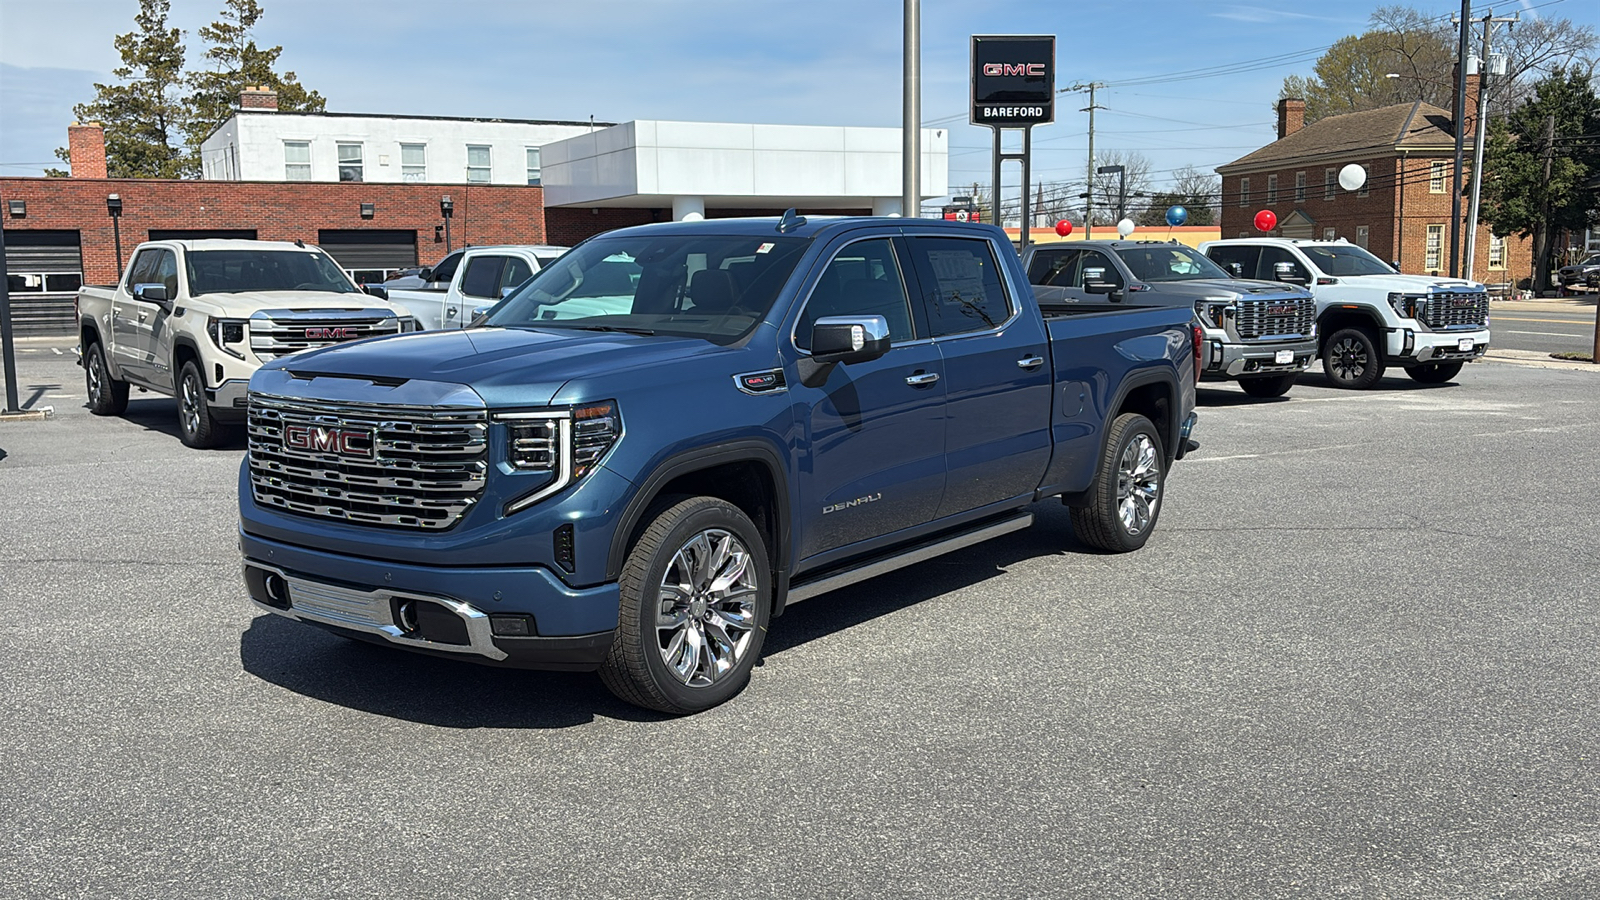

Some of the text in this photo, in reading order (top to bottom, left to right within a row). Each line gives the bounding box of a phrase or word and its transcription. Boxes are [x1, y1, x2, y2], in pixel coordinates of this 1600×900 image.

[983, 62, 1046, 77] GMC
[983, 106, 1044, 118] BAREFORD
[305, 327, 358, 339] GMC
[286, 424, 372, 456] GMC
[822, 492, 882, 515] DENALI
